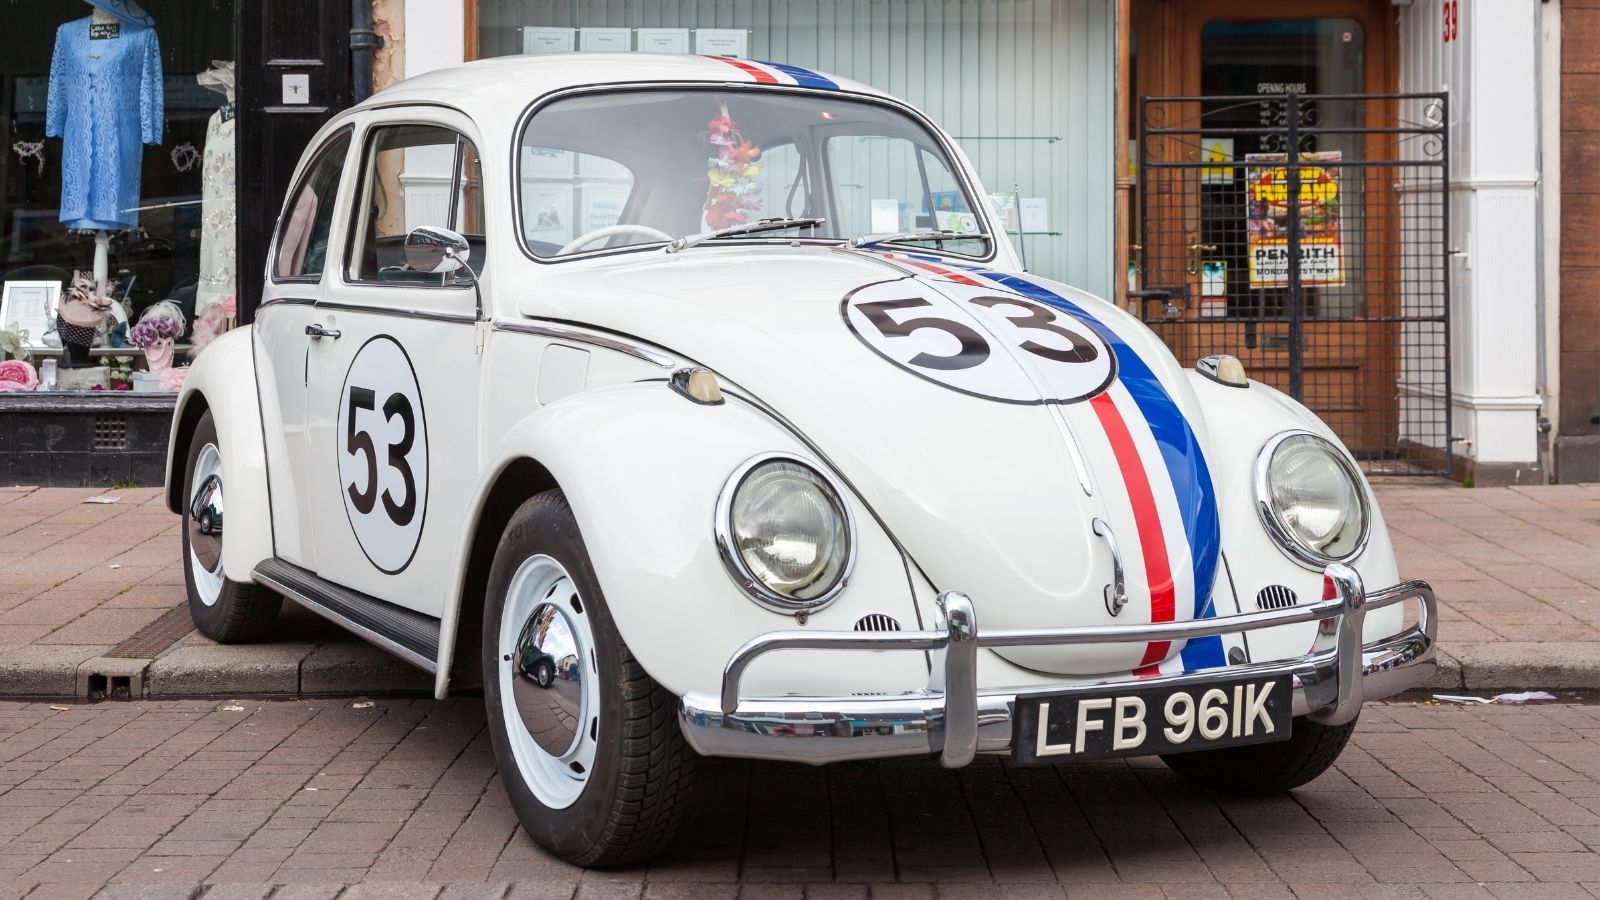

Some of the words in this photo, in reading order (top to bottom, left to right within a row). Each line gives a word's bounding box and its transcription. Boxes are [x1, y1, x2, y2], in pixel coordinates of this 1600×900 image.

[1443, 1, 1457, 43] 39
[1257, 83, 1284, 93] OPENING
[1285, 83, 1306, 93] HOURS
[1254, 182, 1338, 202] FUNAND
[854, 295, 1098, 371] 53
[347, 385, 417, 527] 53
[1036, 695, 1147, 757] LFB
[1163, 681, 1276, 745] 961K
